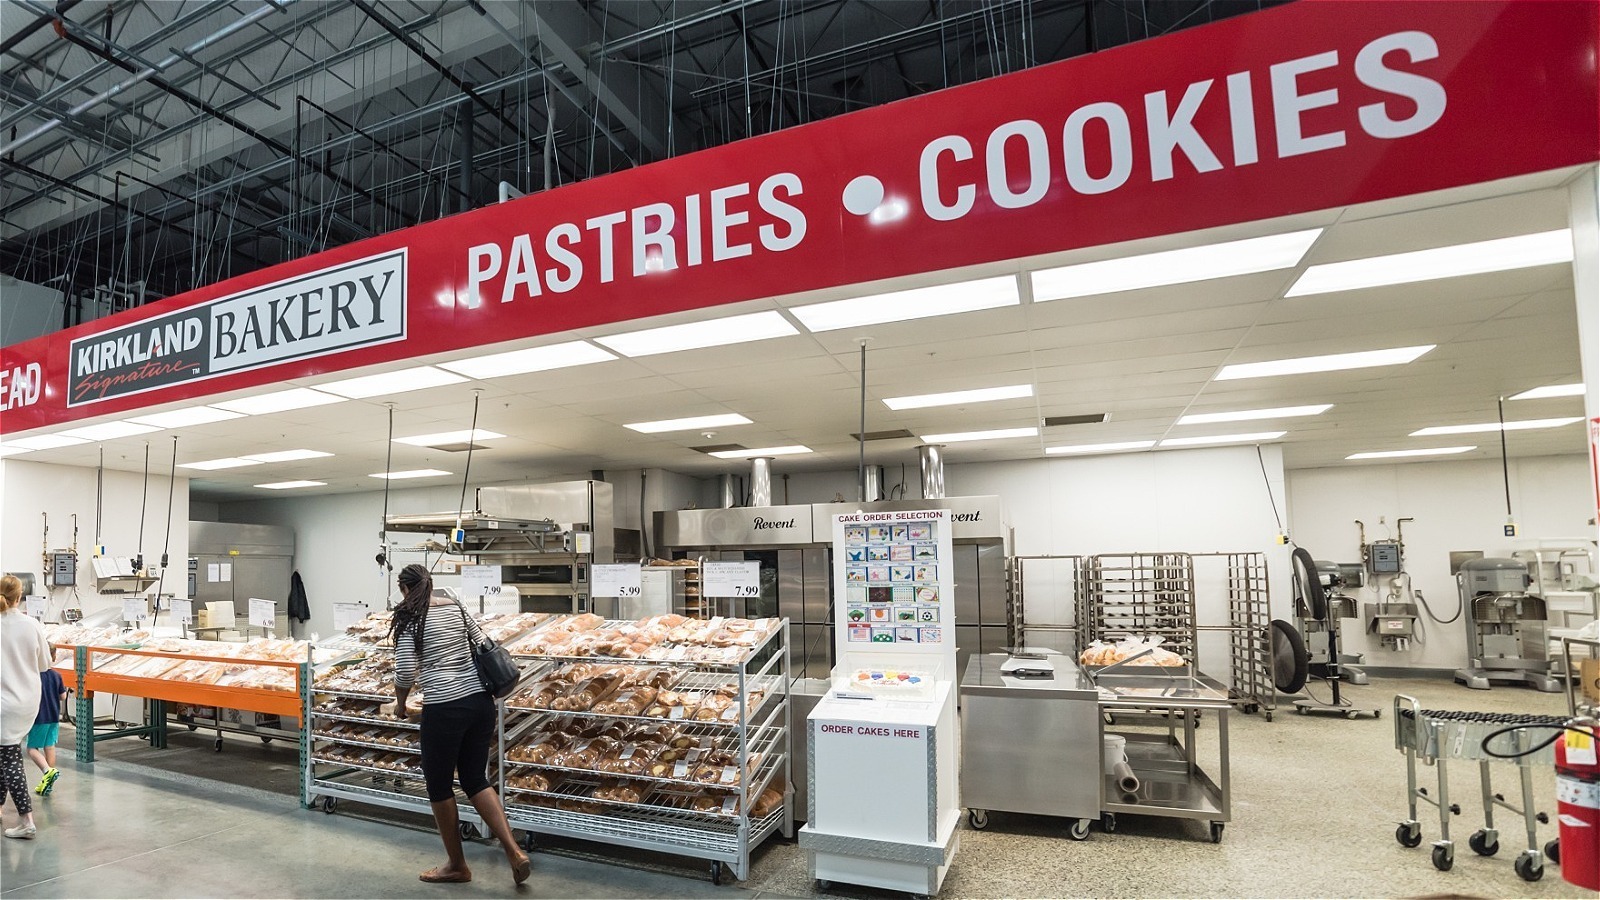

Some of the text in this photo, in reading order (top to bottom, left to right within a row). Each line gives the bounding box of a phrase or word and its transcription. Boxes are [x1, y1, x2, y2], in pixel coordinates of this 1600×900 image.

[468, 30, 1447, 310] PASTRIES COOKIES
[213, 269, 395, 360] BAKERY
[77, 317, 203, 377] KIRKLAND
[75, 360, 200, 400] Signature
[753, 516, 795, 530] Revent
[838, 511, 943, 523] CAKE ORDER SELECTION
[484, 585, 501, 595] 7.99
[619, 586, 641, 596] 5.99
[735, 585, 759, 596] 7.99
[821, 724, 920, 739] ORDER CAKES HERE
